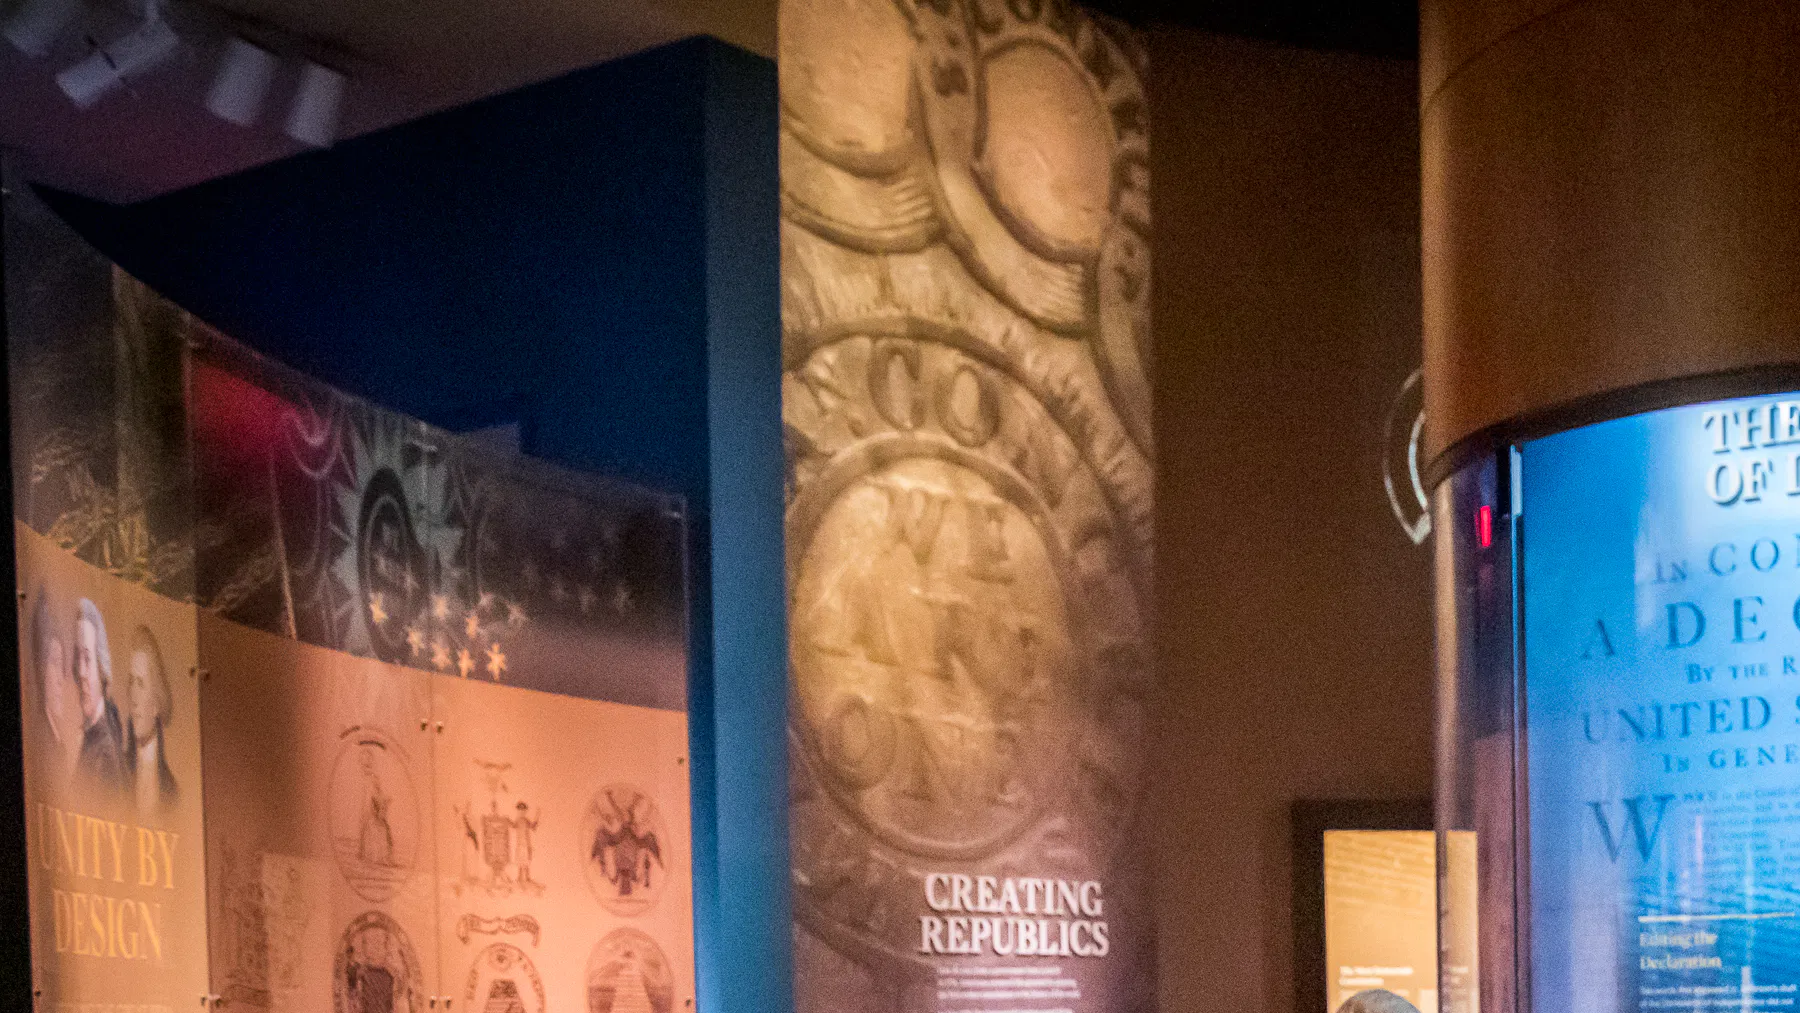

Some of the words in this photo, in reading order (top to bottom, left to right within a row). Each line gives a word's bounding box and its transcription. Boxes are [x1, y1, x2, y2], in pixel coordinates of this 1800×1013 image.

[1705, 458, 1774, 507] OF
[1581, 617, 1616, 661] A
[1582, 695, 1772, 745] UNITED
[39, 803, 128, 882] UNITY
[135, 827, 180, 889] BY
[925, 873, 1104, 917] CREATING
[52, 889, 162, 960] DESIGN
[919, 915, 1110, 957] REPUBLICS
